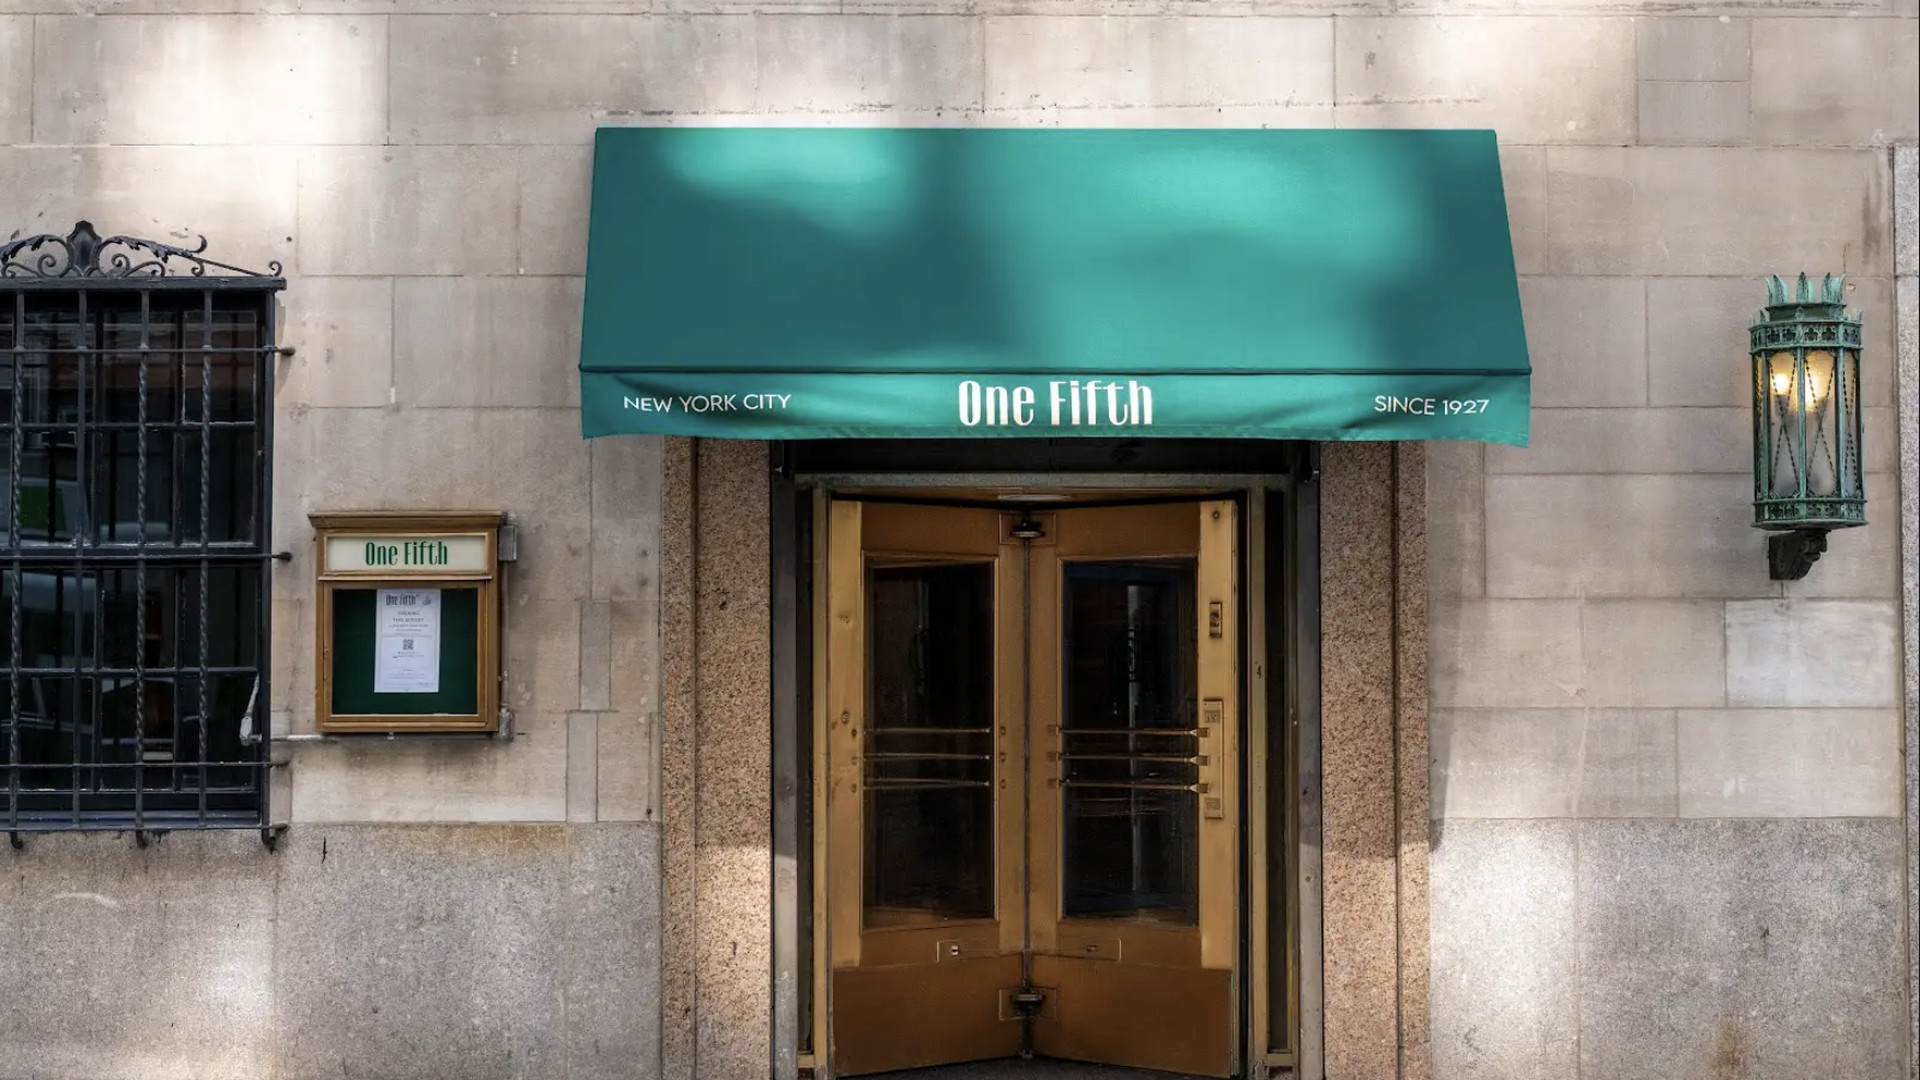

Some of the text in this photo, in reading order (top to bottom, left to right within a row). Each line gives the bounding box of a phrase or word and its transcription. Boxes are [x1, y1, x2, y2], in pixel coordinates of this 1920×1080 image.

[623, 393, 792, 413] NEW YORK CITY
[958, 380, 1153, 427] One Fifth
[1374, 395, 1490, 416] SINCE 1927
[365, 541, 448, 566] One Fifth
